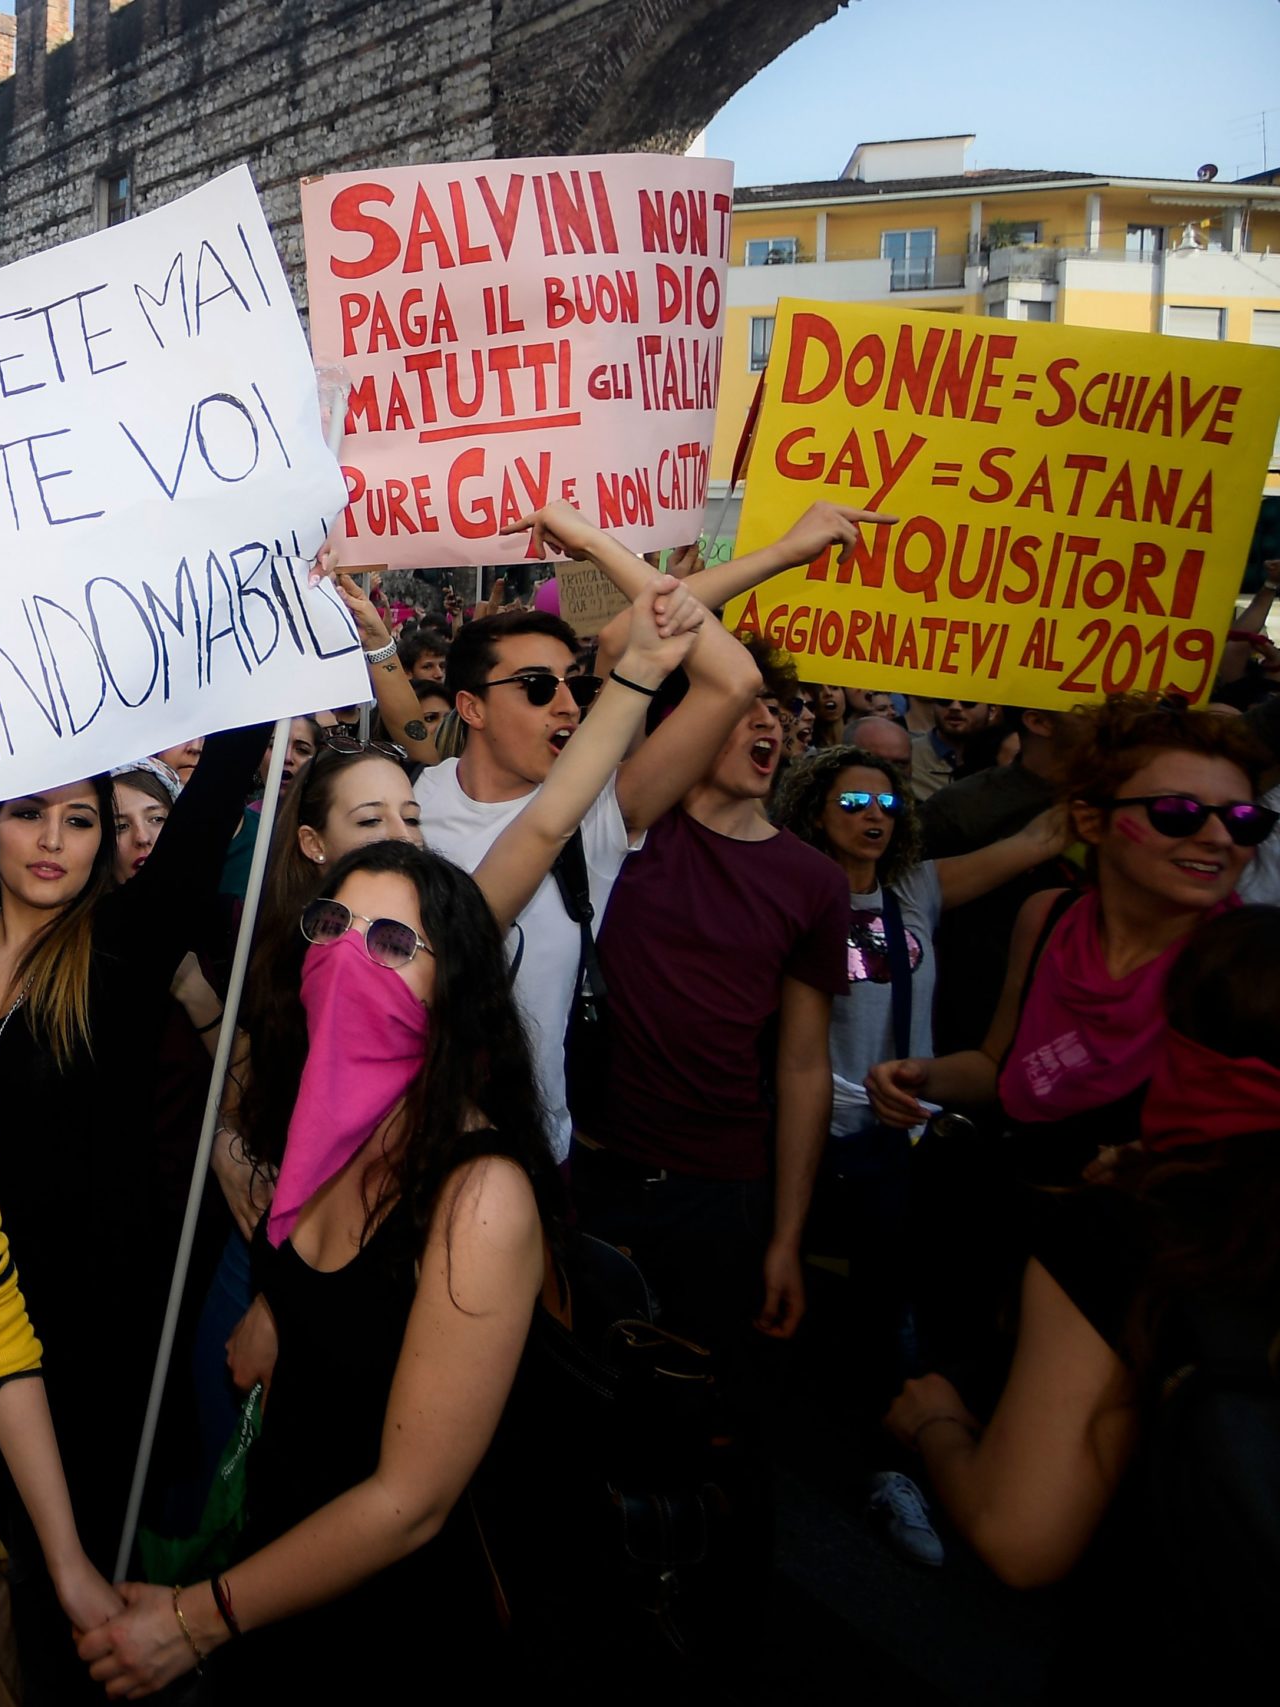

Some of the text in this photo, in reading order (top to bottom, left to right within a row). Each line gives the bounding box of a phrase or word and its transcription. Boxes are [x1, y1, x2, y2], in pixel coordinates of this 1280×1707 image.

[329, 170, 620, 280] SALVINI
[637, 188, 708, 256] NON
[133, 222, 272, 350] MAI
[339, 262, 721, 358] PAGA IL BUON DIO
[586, 362, 633, 400] GLI
[781, 312, 1018, 425] DONNE
[1035, 357, 1243, 445] SCHIAVE
[119, 382, 292, 501] VOI
[774, 426, 928, 513] GAY
[968, 446, 1215, 534] SATANA
[341, 464, 440, 538] PURE
[446, 446, 553, 559] GAY
[596, 466, 655, 529] NON
[735, 590, 1215, 706] AGGIORNATEVI AL 2019
